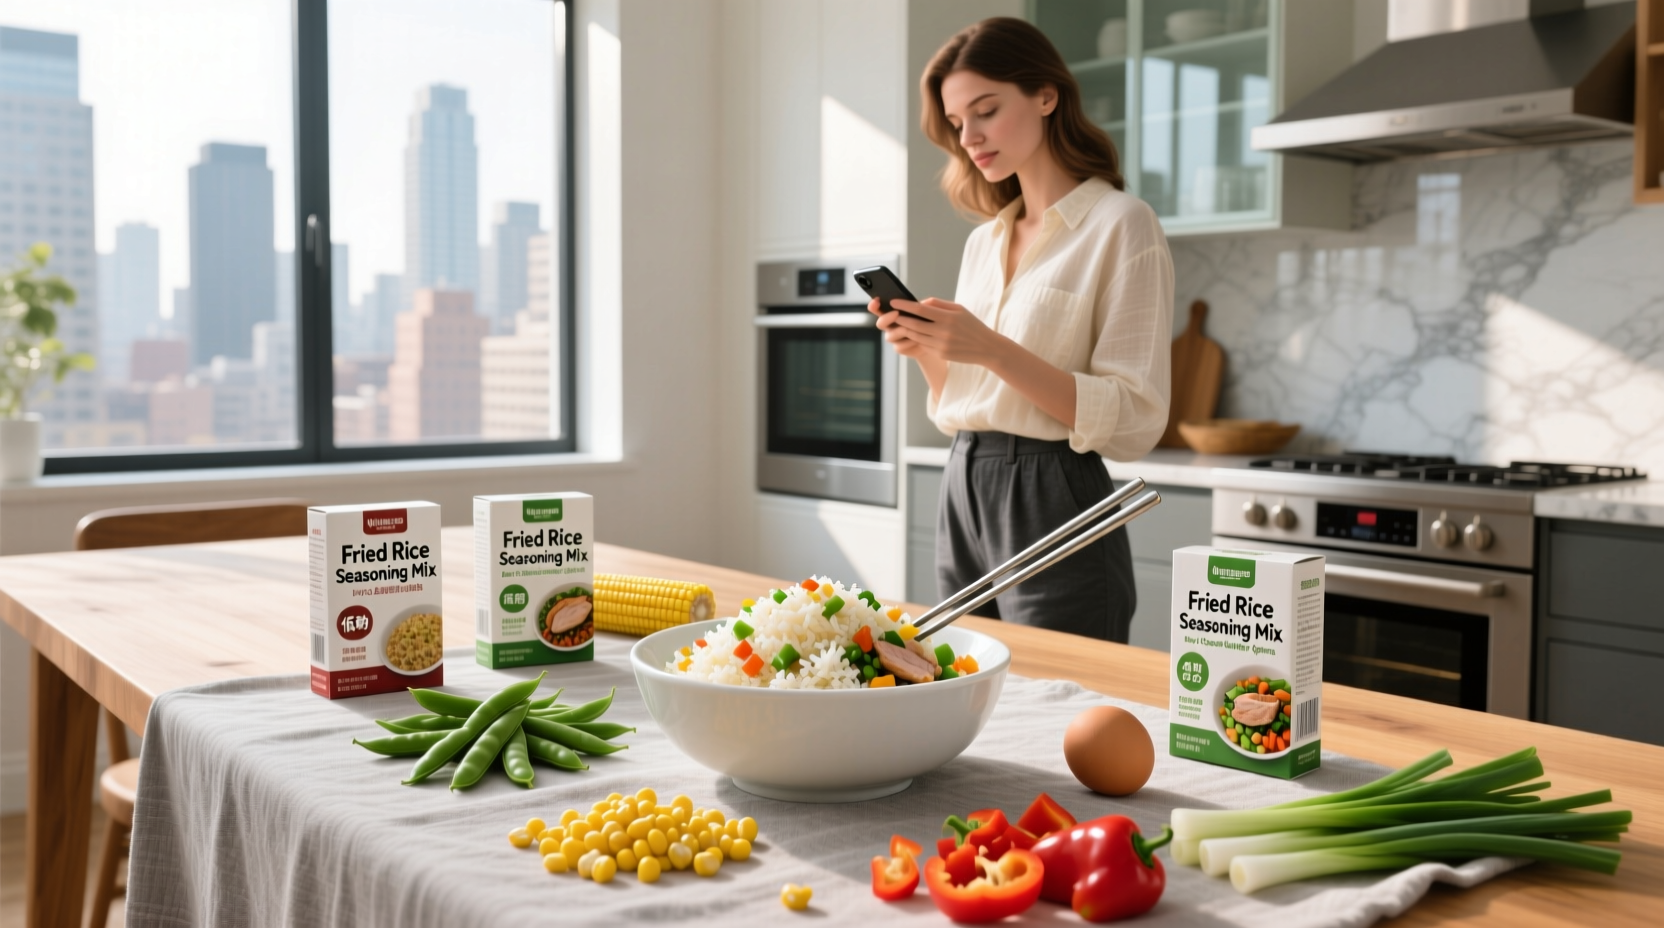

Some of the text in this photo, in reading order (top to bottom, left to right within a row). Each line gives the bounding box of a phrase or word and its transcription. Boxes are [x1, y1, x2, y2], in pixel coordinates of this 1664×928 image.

[503, 528, 583, 548] Fried Rice
[342, 541, 430, 564] Fried Rice
[335, 561, 437, 584] Seasoning Mix
[1188, 590, 1274, 619] Fried Rice
[1179, 612, 1283, 643] Seasoning Mix
